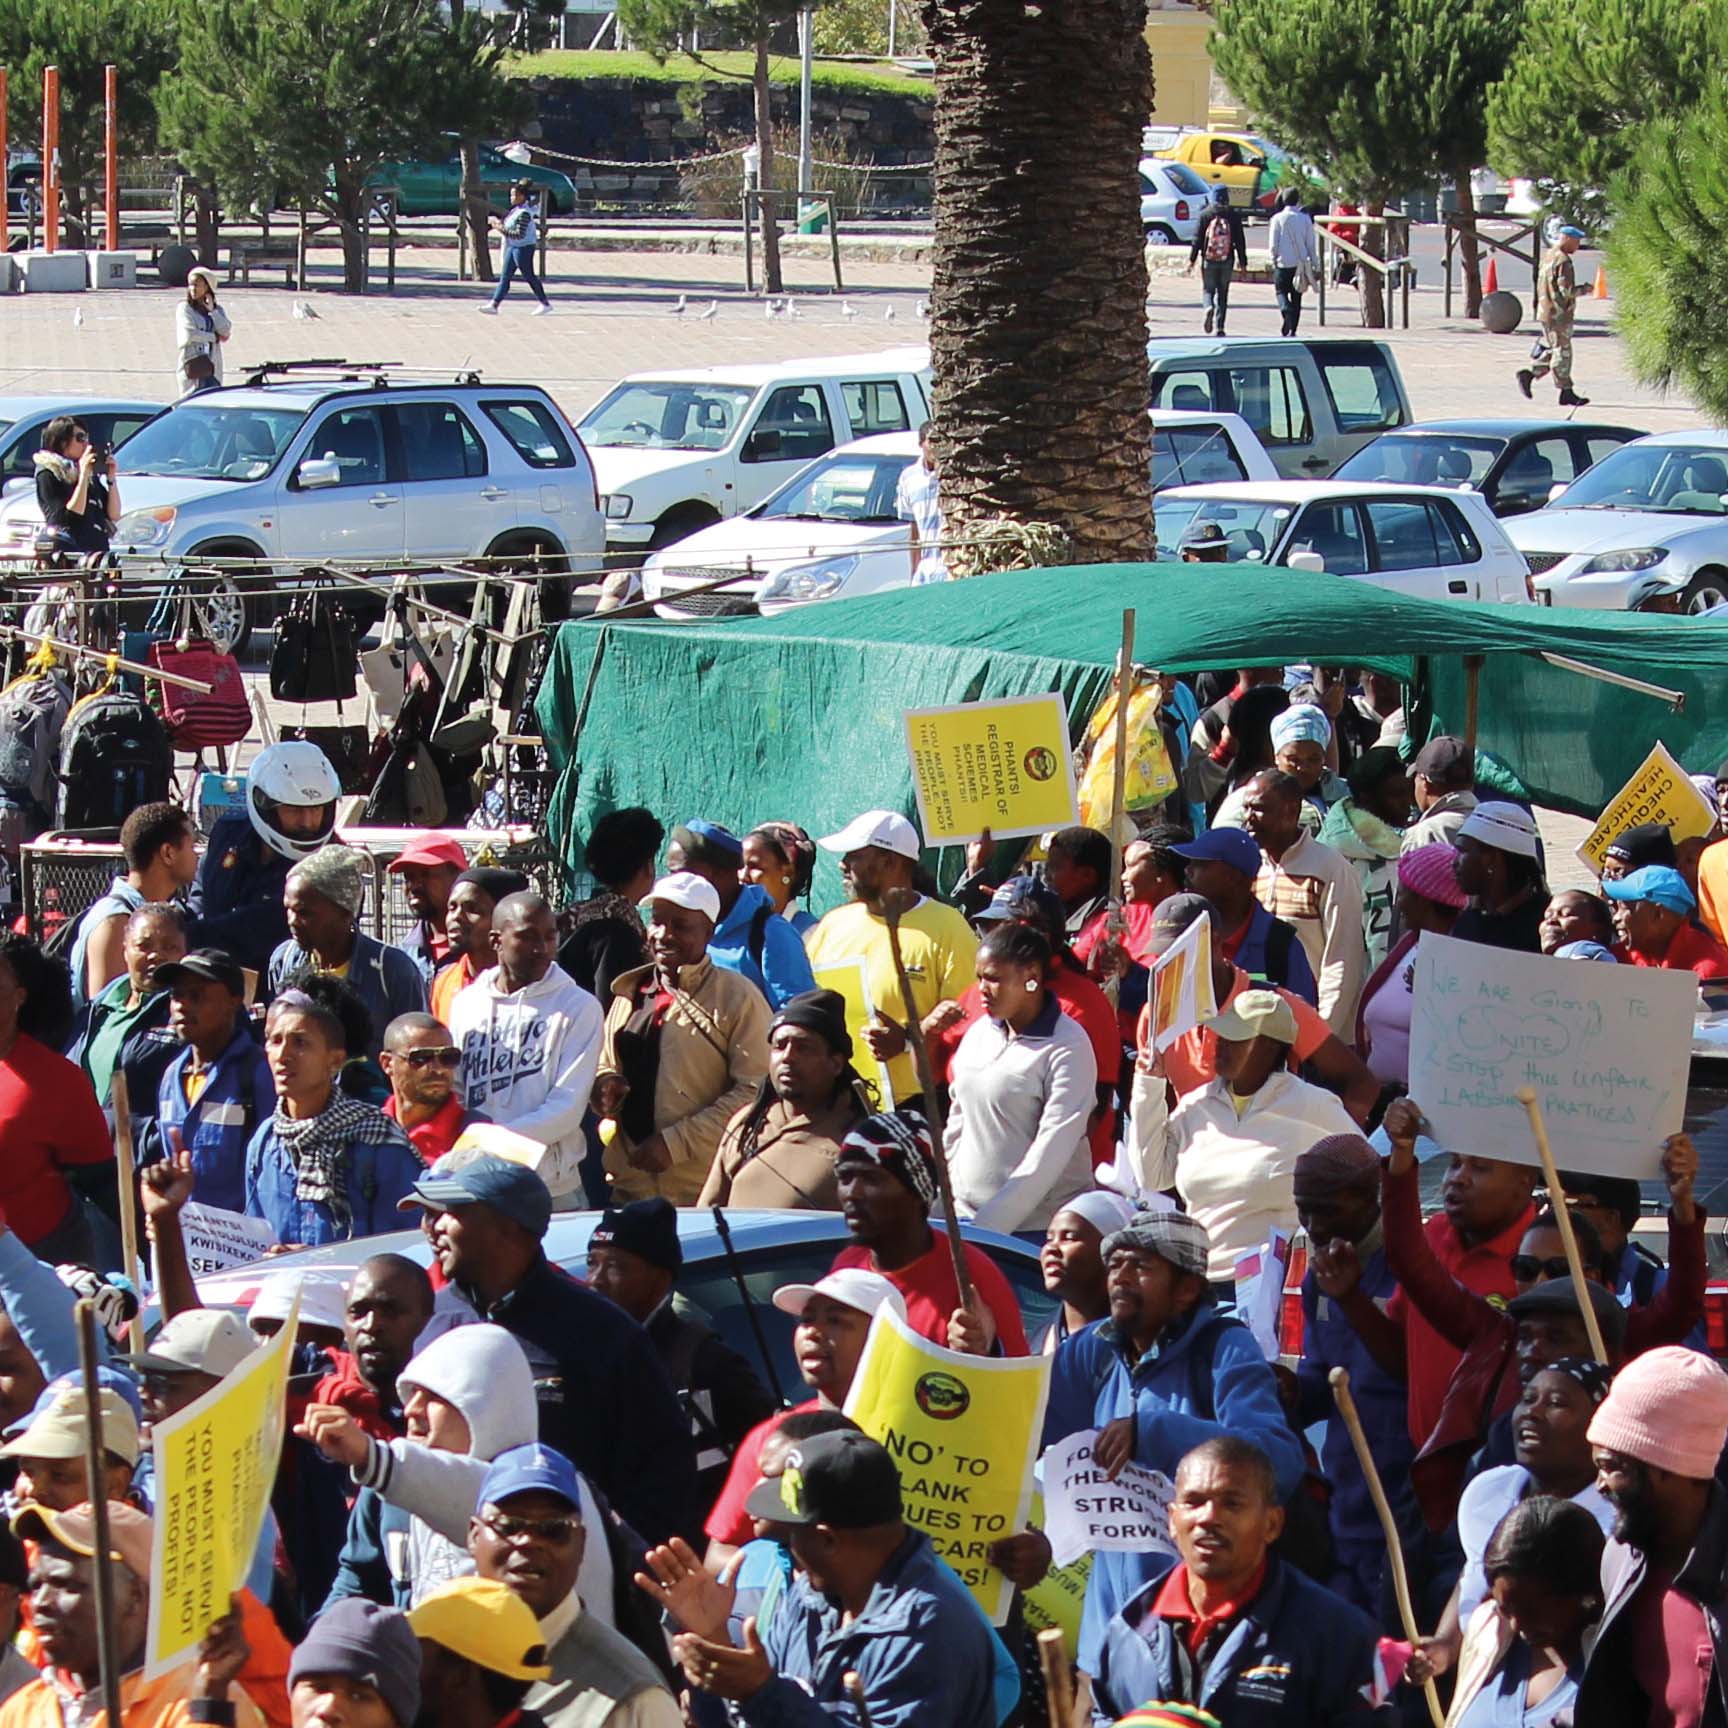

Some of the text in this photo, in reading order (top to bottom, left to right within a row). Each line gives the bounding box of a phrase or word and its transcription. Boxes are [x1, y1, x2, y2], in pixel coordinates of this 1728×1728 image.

[919, 723, 929, 747] THE
[936, 806, 946, 831] NOT
[929, 722, 954, 829] YOU MUST SERVE
[962, 743, 978, 803] SCHEMES
[975, 744, 992, 800] MEDICAL
[987, 724, 1009, 816] REGISTRAR OF
[1004, 741, 1021, 796] PHANTSI
[1586, 767, 1665, 855] HEALTHCARE
[1477, 980, 1513, 1000] ARE
[184, 1432, 197, 1481] THE
[953, 1455, 990, 1477] TO
[1063, 1470, 1109, 1491] THE
[898, 1472, 972, 1504] LANK
[164, 1493, 181, 1600] PROFITS!
[198, 1421, 215, 1627] YOU MUST SERVE
[972, 1514, 1006, 1532] TO
[1089, 1524, 1170, 1543] FORWA
[180, 1590, 196, 1635] NOT
